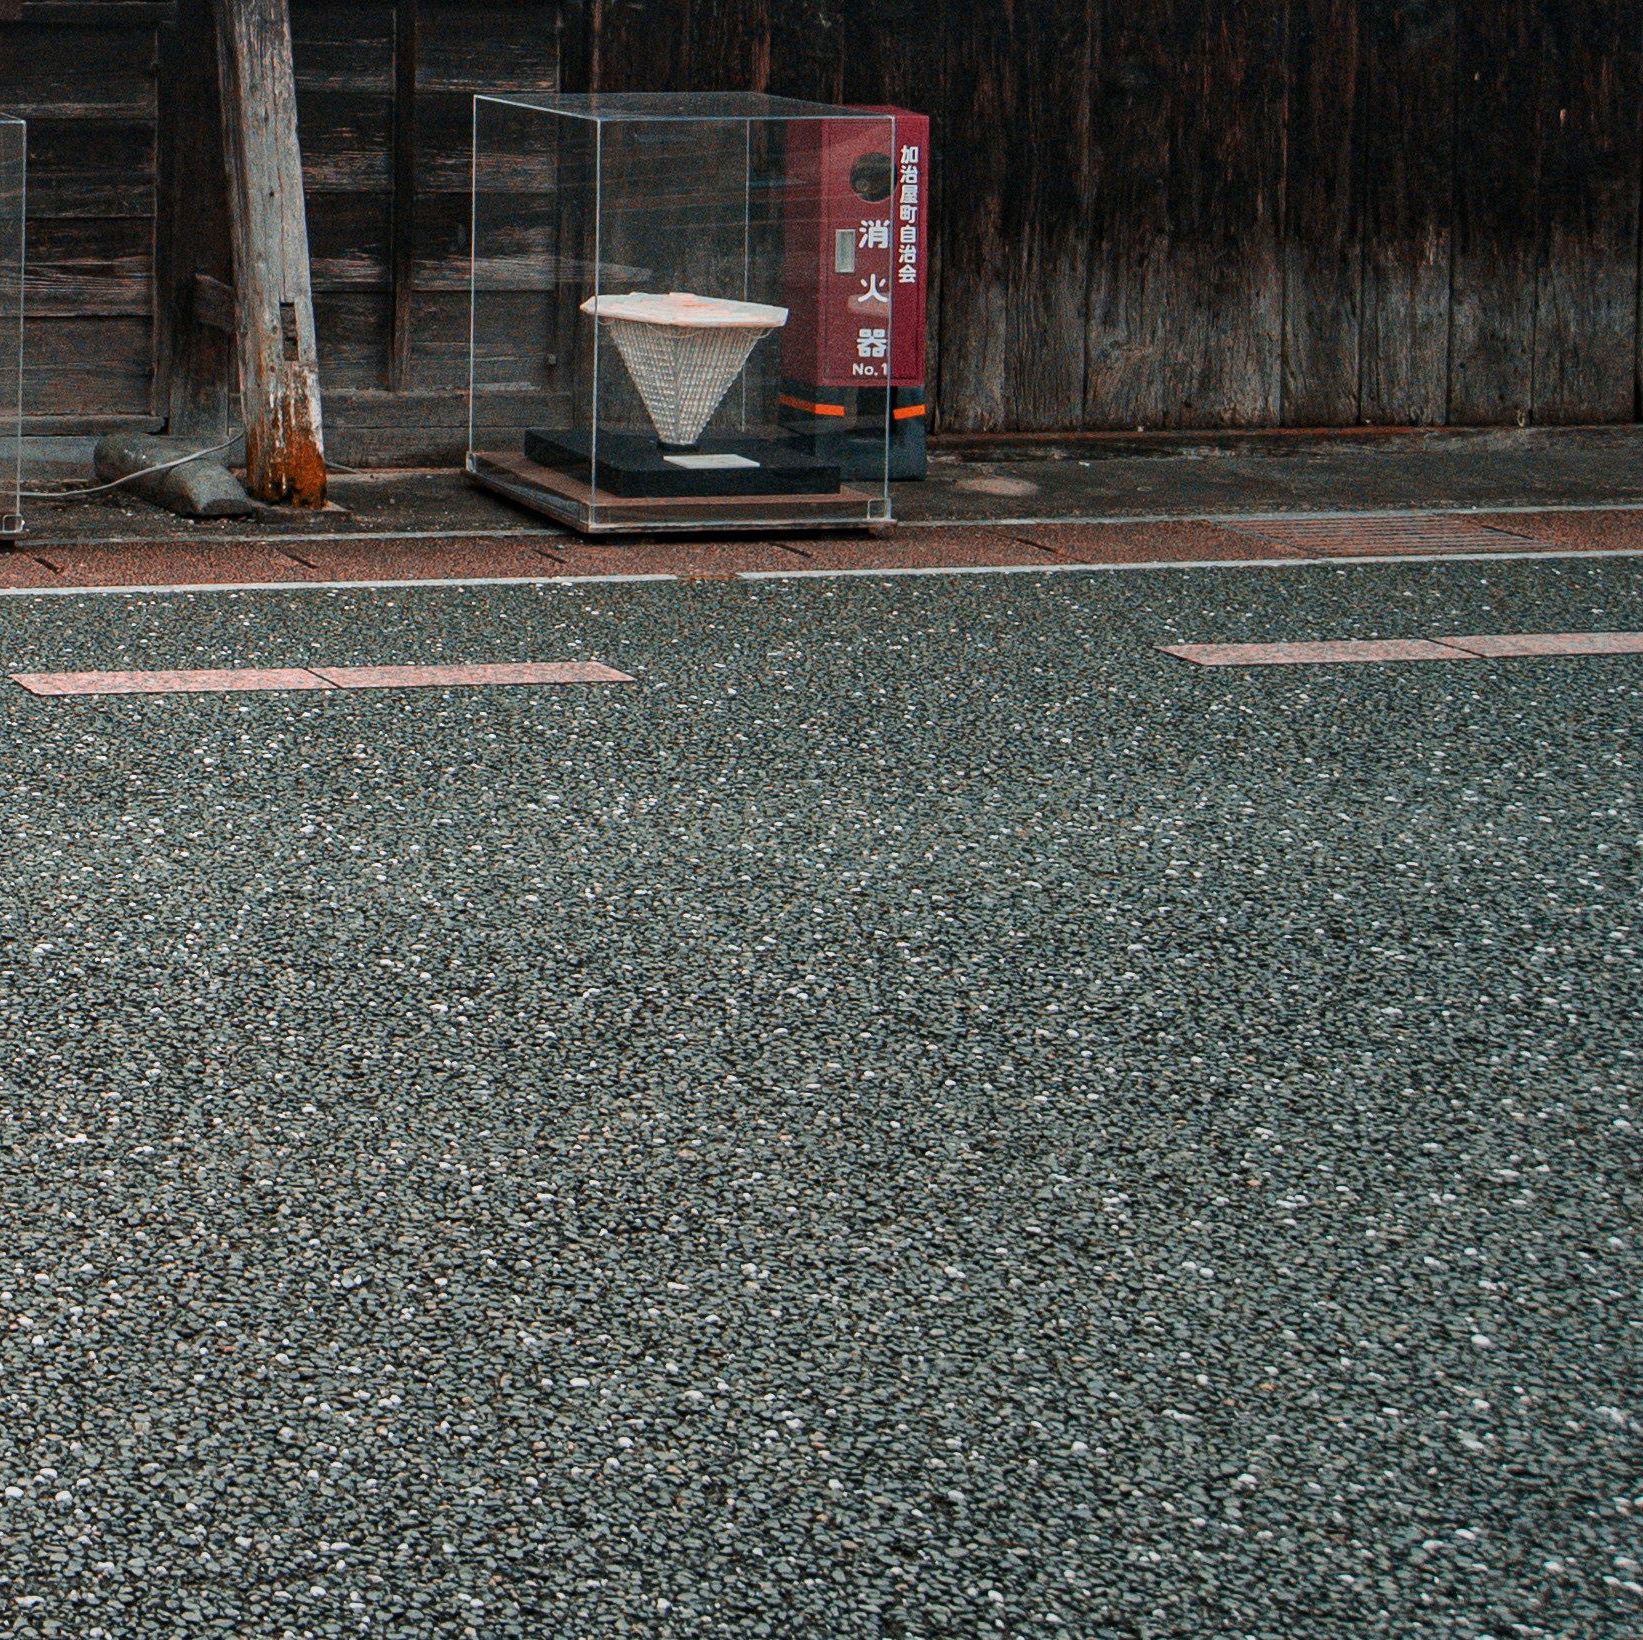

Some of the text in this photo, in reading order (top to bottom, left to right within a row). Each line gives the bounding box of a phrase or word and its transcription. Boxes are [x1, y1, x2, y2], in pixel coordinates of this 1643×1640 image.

[898, 144, 920, 284] 加治屋町自治会
[856, 219, 891, 359] 消火器
